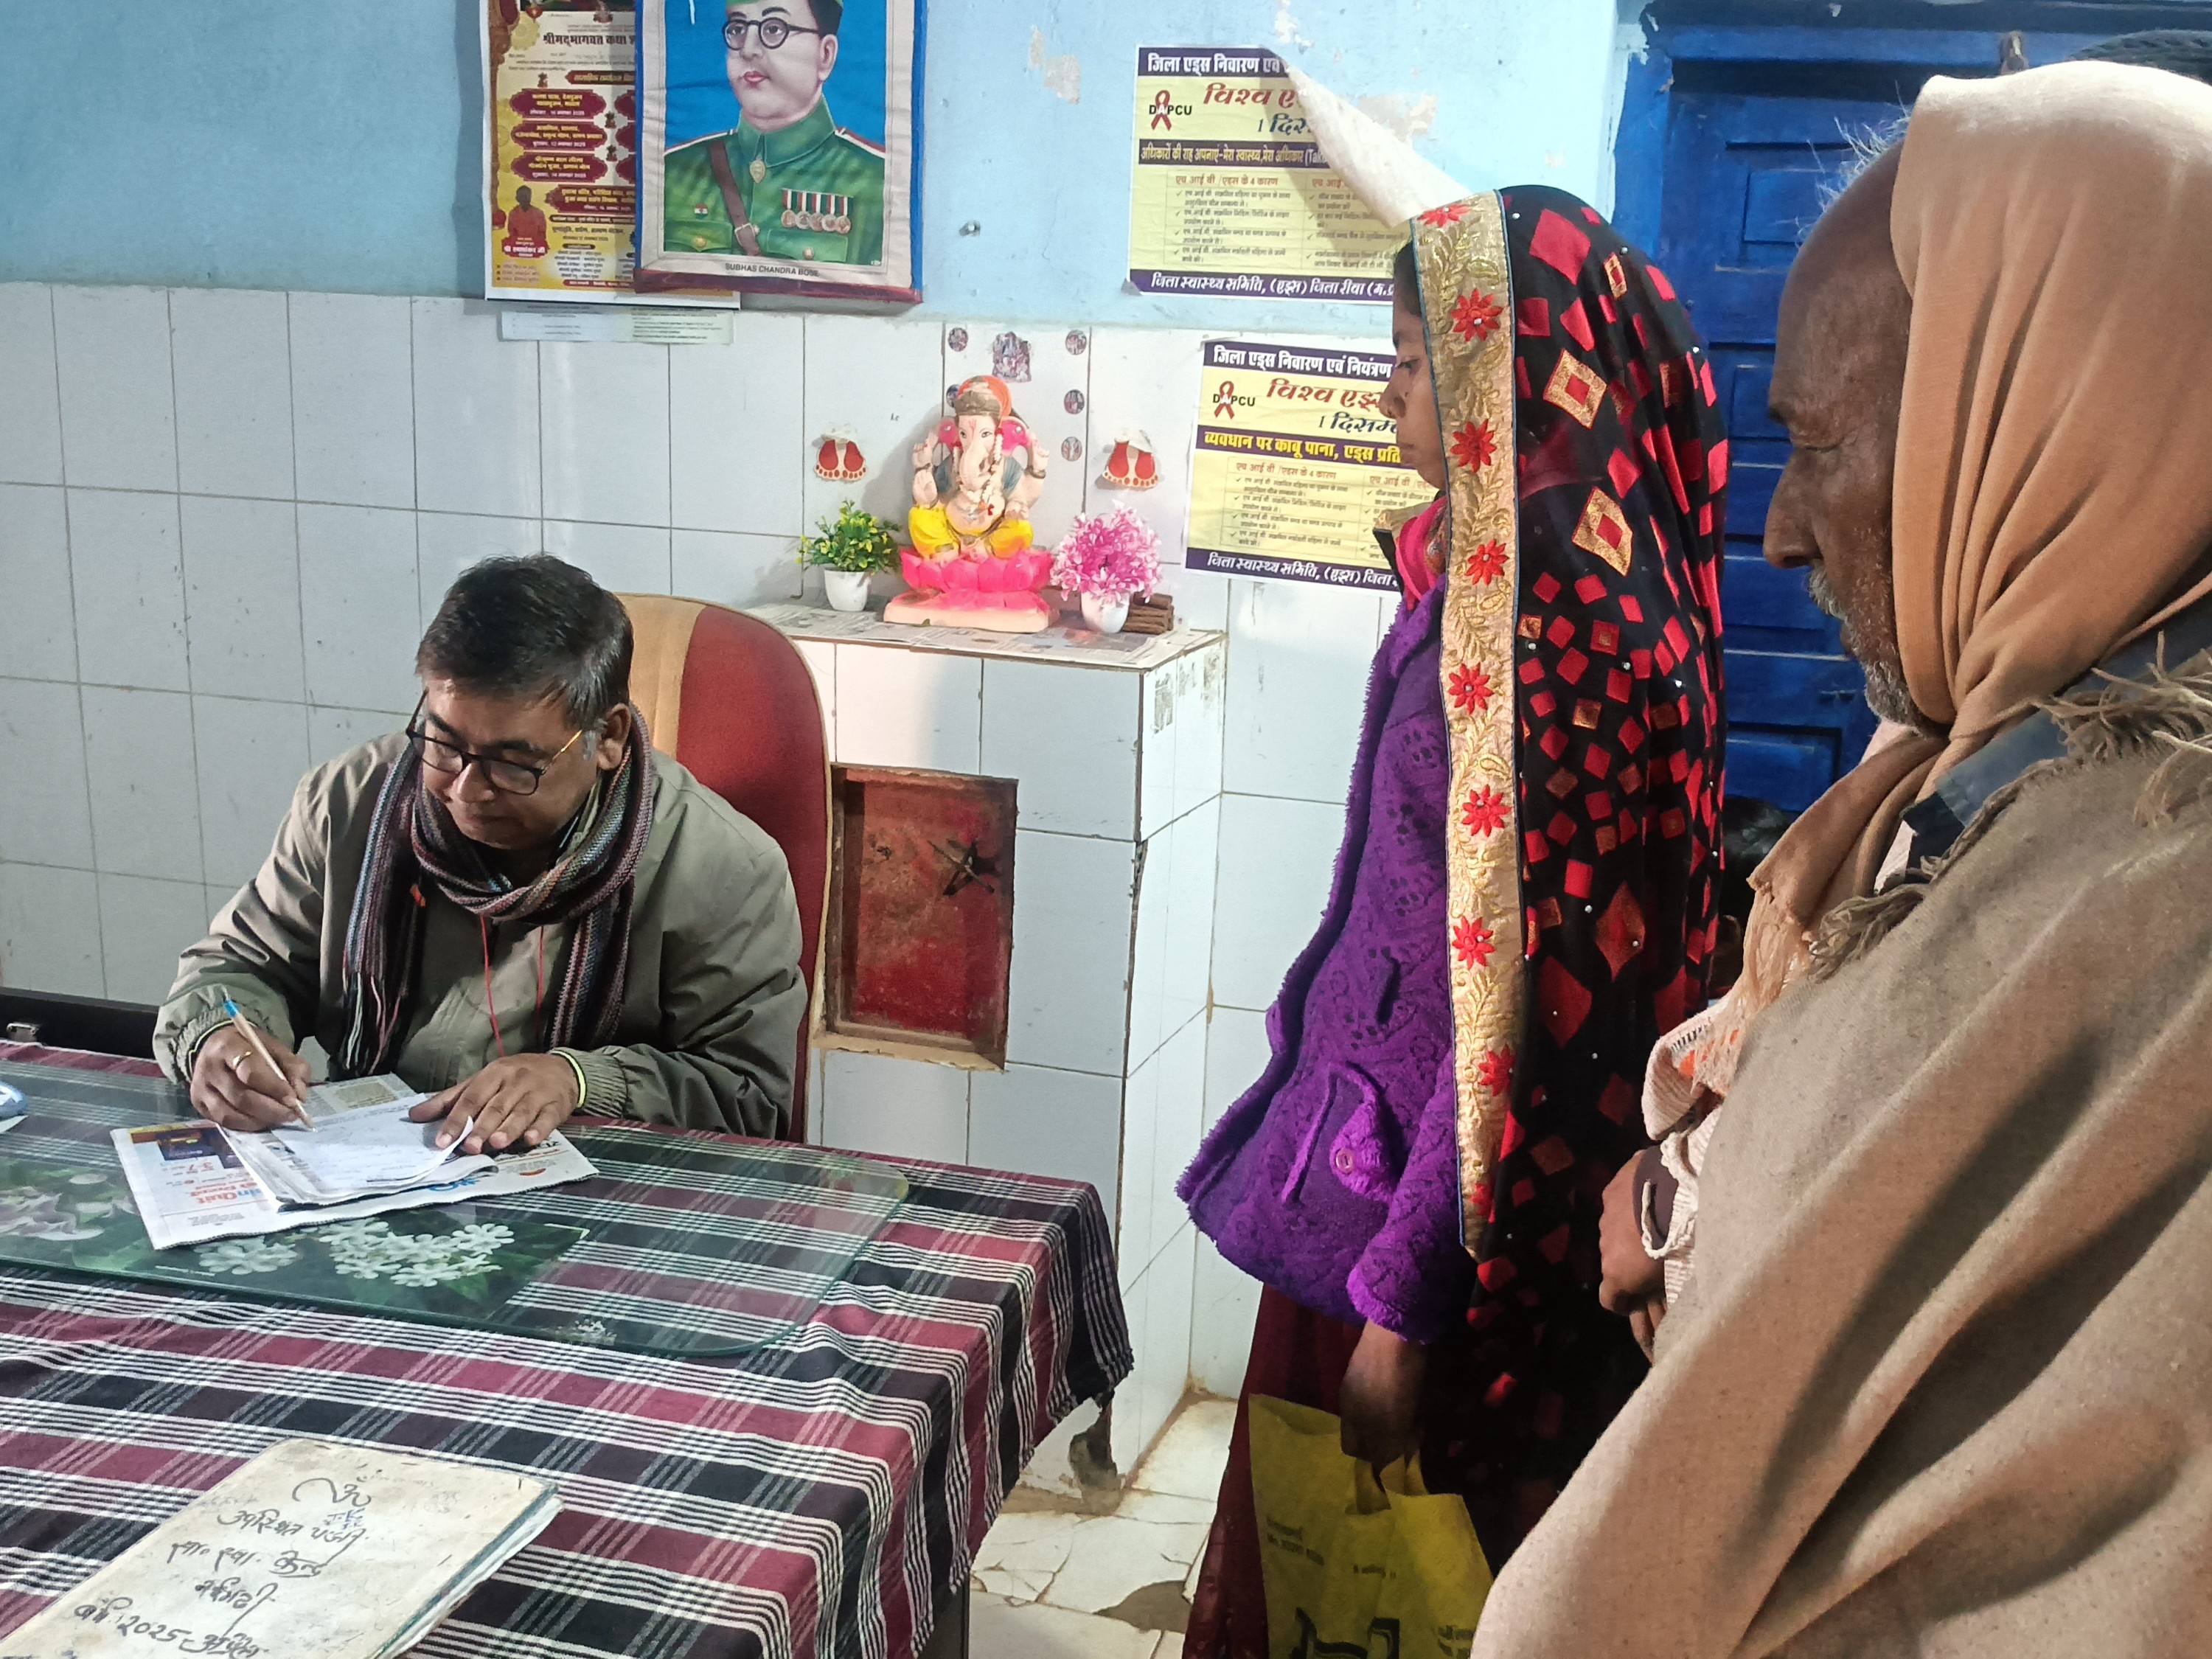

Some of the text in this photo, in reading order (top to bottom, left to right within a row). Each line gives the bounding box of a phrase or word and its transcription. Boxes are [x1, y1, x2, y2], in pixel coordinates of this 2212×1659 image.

[1147, 53, 1180, 72] जिला
[1183, 57, 1211, 76] एड्स
[1214, 53, 1260, 73] निवारण
[1203, 83, 1275, 105] विश्व
[1149, 104, 1192, 116] DAPCU
[1141, 142, 1171, 160] अधिकारों
[1172, 142, 1181, 159] की
[1176, 175, 1186, 185] एच
[1189, 173, 1204, 186] आई
[1207, 173, 1215, 184] वी
[1241, 174, 1248, 184] के
[1257, 177, 1278, 185] कारण
[726, 262, 757, 273] SUBHAS
[758, 265, 796, 275] CHANDRA
[1152, 272, 1178, 288] जिला
[1180, 276, 1224, 291] स्वास्थ्य
[1225, 275, 1266, 294] समिति,
[1310, 278, 1338, 294] जिला
[1340, 279, 1366, 295] रीवा
[1214, 345, 1393, 378] जिला एड्स निवारण एवं नियंत्रण
[1212, 393, 1256, 407] DAPCU
[1266, 378, 1338, 403] विश्व
[1204, 431, 1253, 449] व्यवधान
[1256, 437, 1273, 451] पर
[1275, 438, 1303, 459] काबू
[1305, 441, 1339, 460] पाना,
[1344, 445, 1374, 464] एड्स
[1237, 462, 1248, 471] एच
[1250, 462, 1265, 473] आई
[1267, 462, 1275, 473] वी
[1300, 467, 1307, 476] के
[1316, 470, 1337, 479] कारण
[1208, 552, 1234, 568] जिला
[1235, 557, 1280, 574] स्वास्थ्य
[1281, 560, 1320, 581] समिति,
[1363, 568, 1393, 586] जिला
